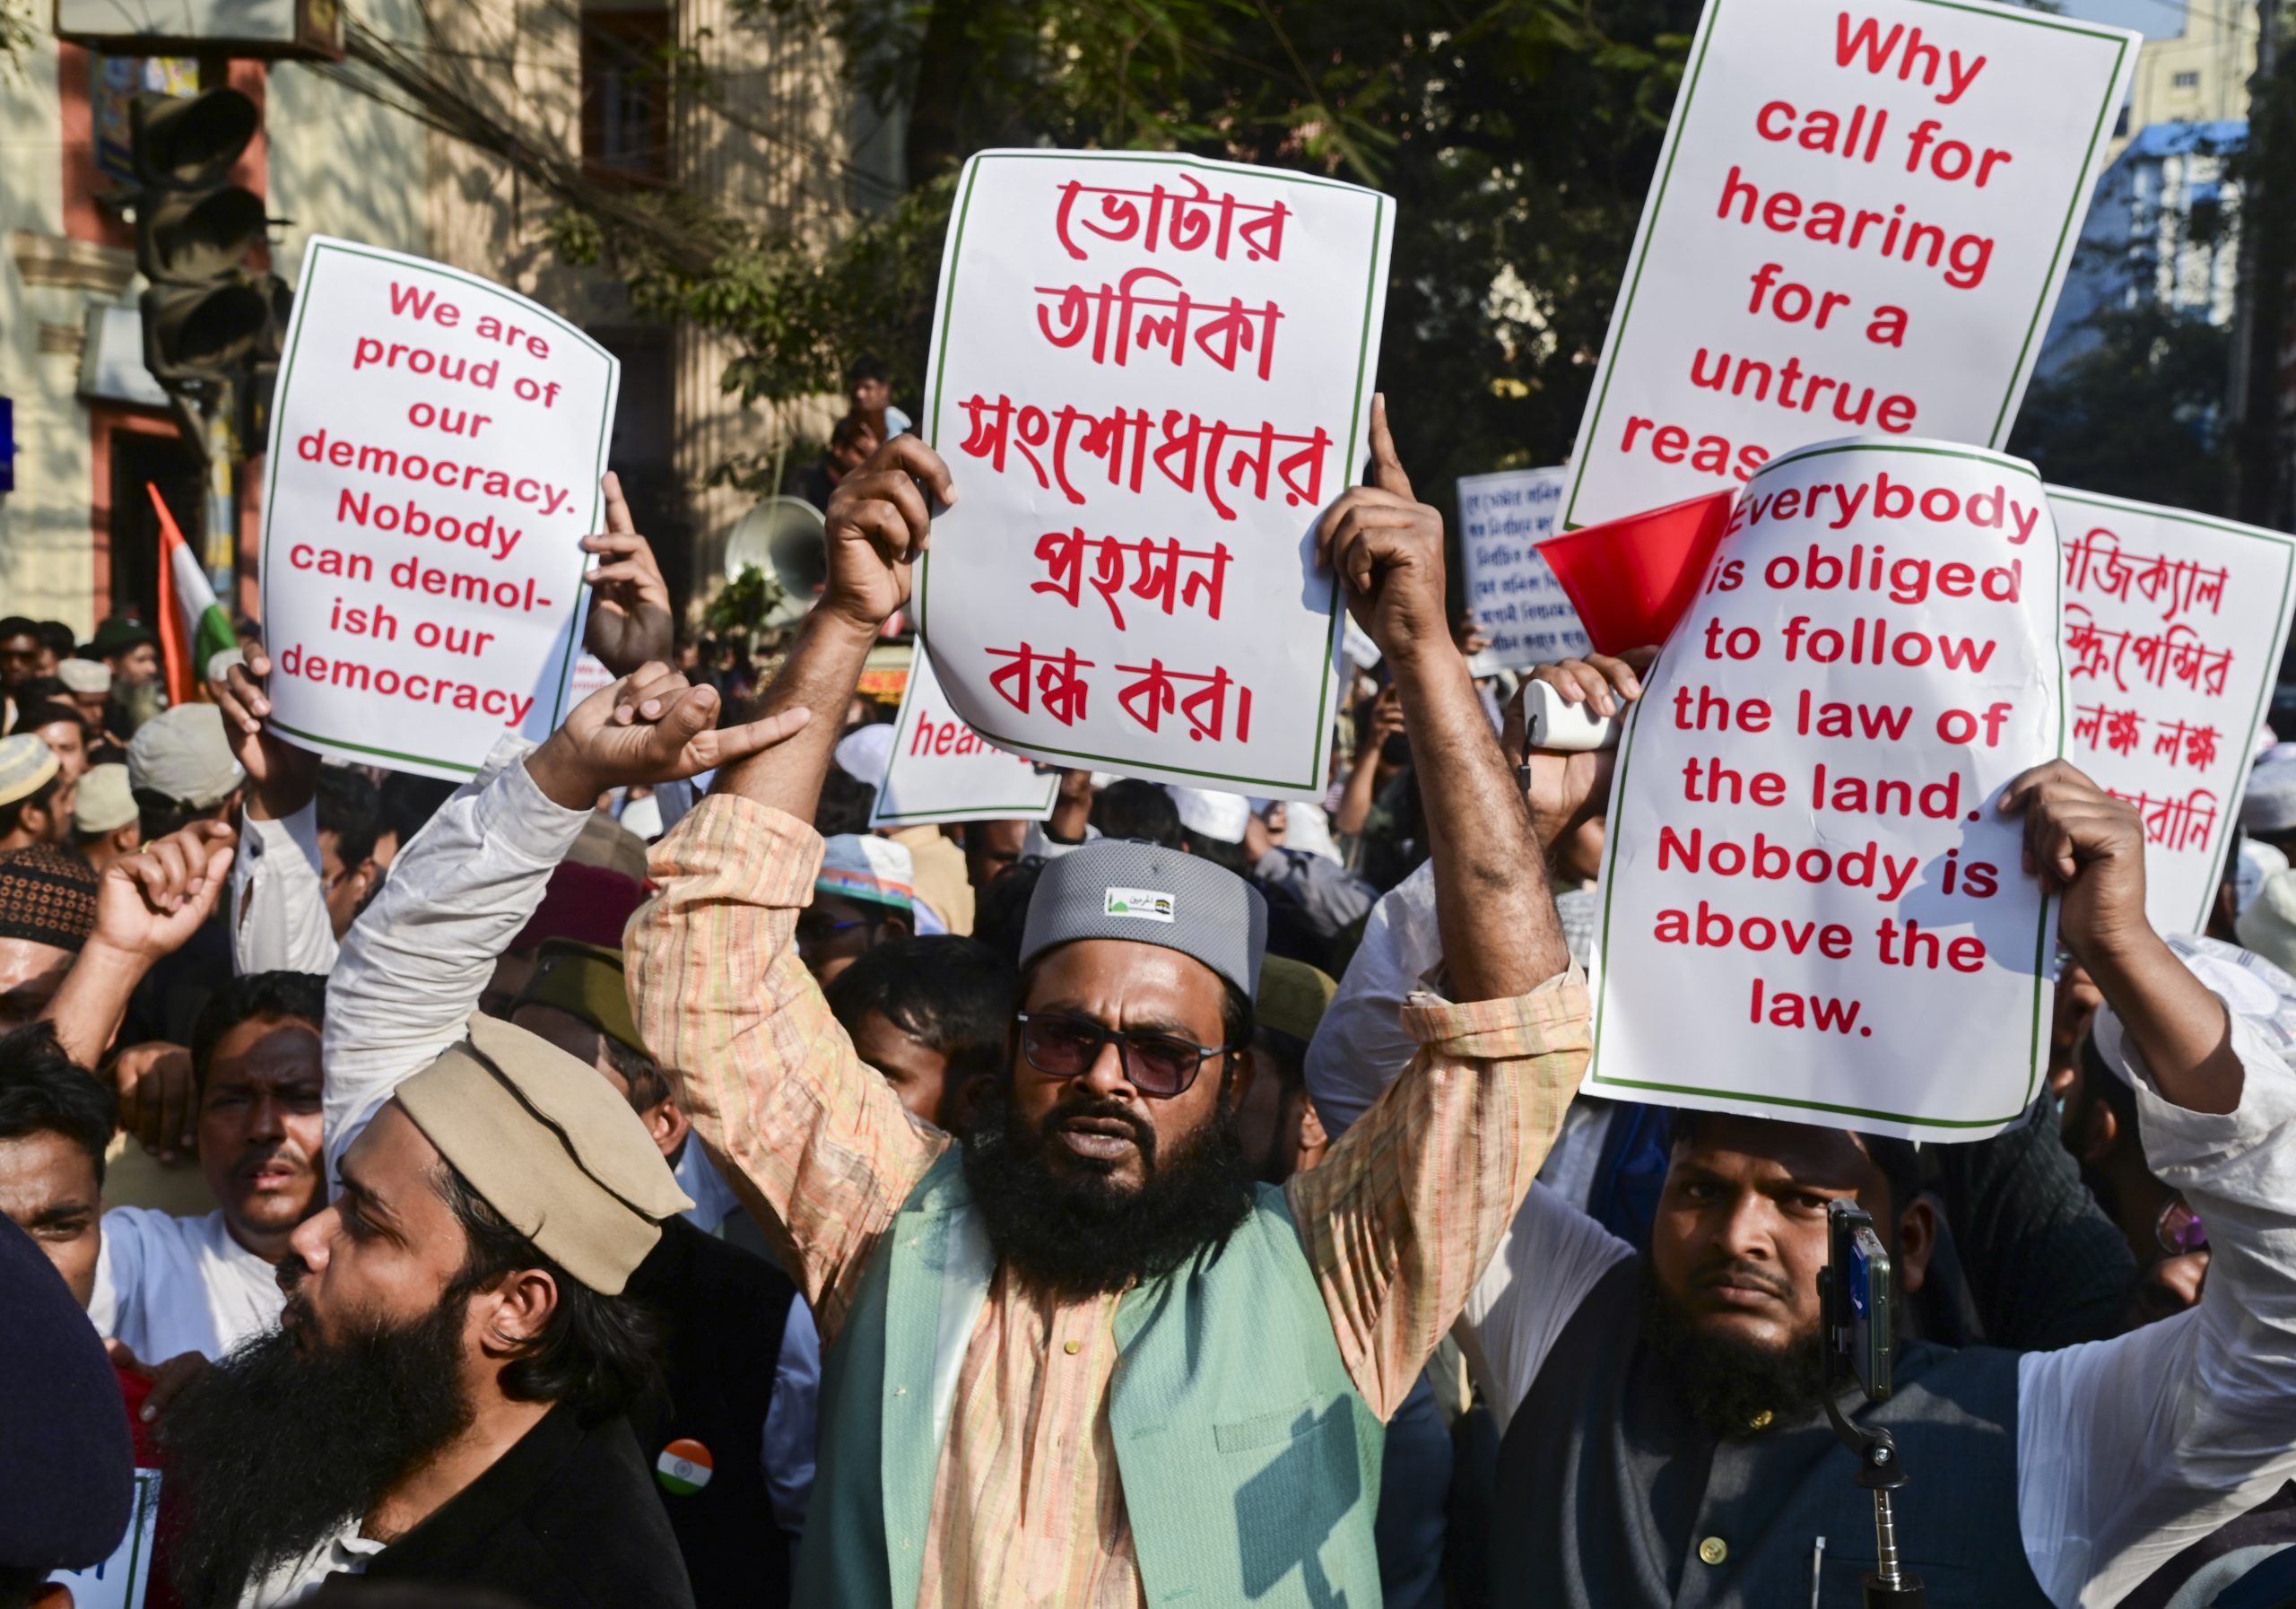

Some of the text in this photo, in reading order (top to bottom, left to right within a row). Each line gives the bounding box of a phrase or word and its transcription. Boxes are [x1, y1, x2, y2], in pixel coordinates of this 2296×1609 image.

[1836, 11, 1987, 106] Why
[1756, 100, 2013, 188] call for
[1055, 173, 1293, 262] ভোটার
[1718, 165, 1996, 291] hearing
[390, 282, 551, 361] We are
[1034, 266, 1286, 382] তালিকা
[1749, 262, 1909, 349] for a
[353, 334, 562, 410] proud of
[1690, 347, 1918, 435] untrue
[408, 402, 492, 439] our
[958, 394, 1335, 521] সংশোধনের
[1621, 415, 1770, 483] reas
[298, 429, 577, 517] democracy.
[1724, 471, 2039, 545] Everybody
[337, 487, 523, 561] Nobody
[290, 544, 553, 613] can demol-
[1030, 526, 1235, 632] প্রহসন
[1706, 544, 2022, 605] is obliged
[330, 596, 496, 657] ish our
[1705, 615, 1996, 674] to follow
[283, 644, 535, 728] democracy
[985, 641, 1096, 727] বন্ধ
[1674, 684, 2013, 747] the law of
[2073, 703, 2223, 773] লক্ষ লক্ষ
[1683, 756, 1980, 822] the land.
[2105, 787, 2218, 853] রানি
[1657, 825, 1999, 902] Nobody is
[1653, 900, 1987, 973] above the
[1750, 978, 1872, 1037] law.
